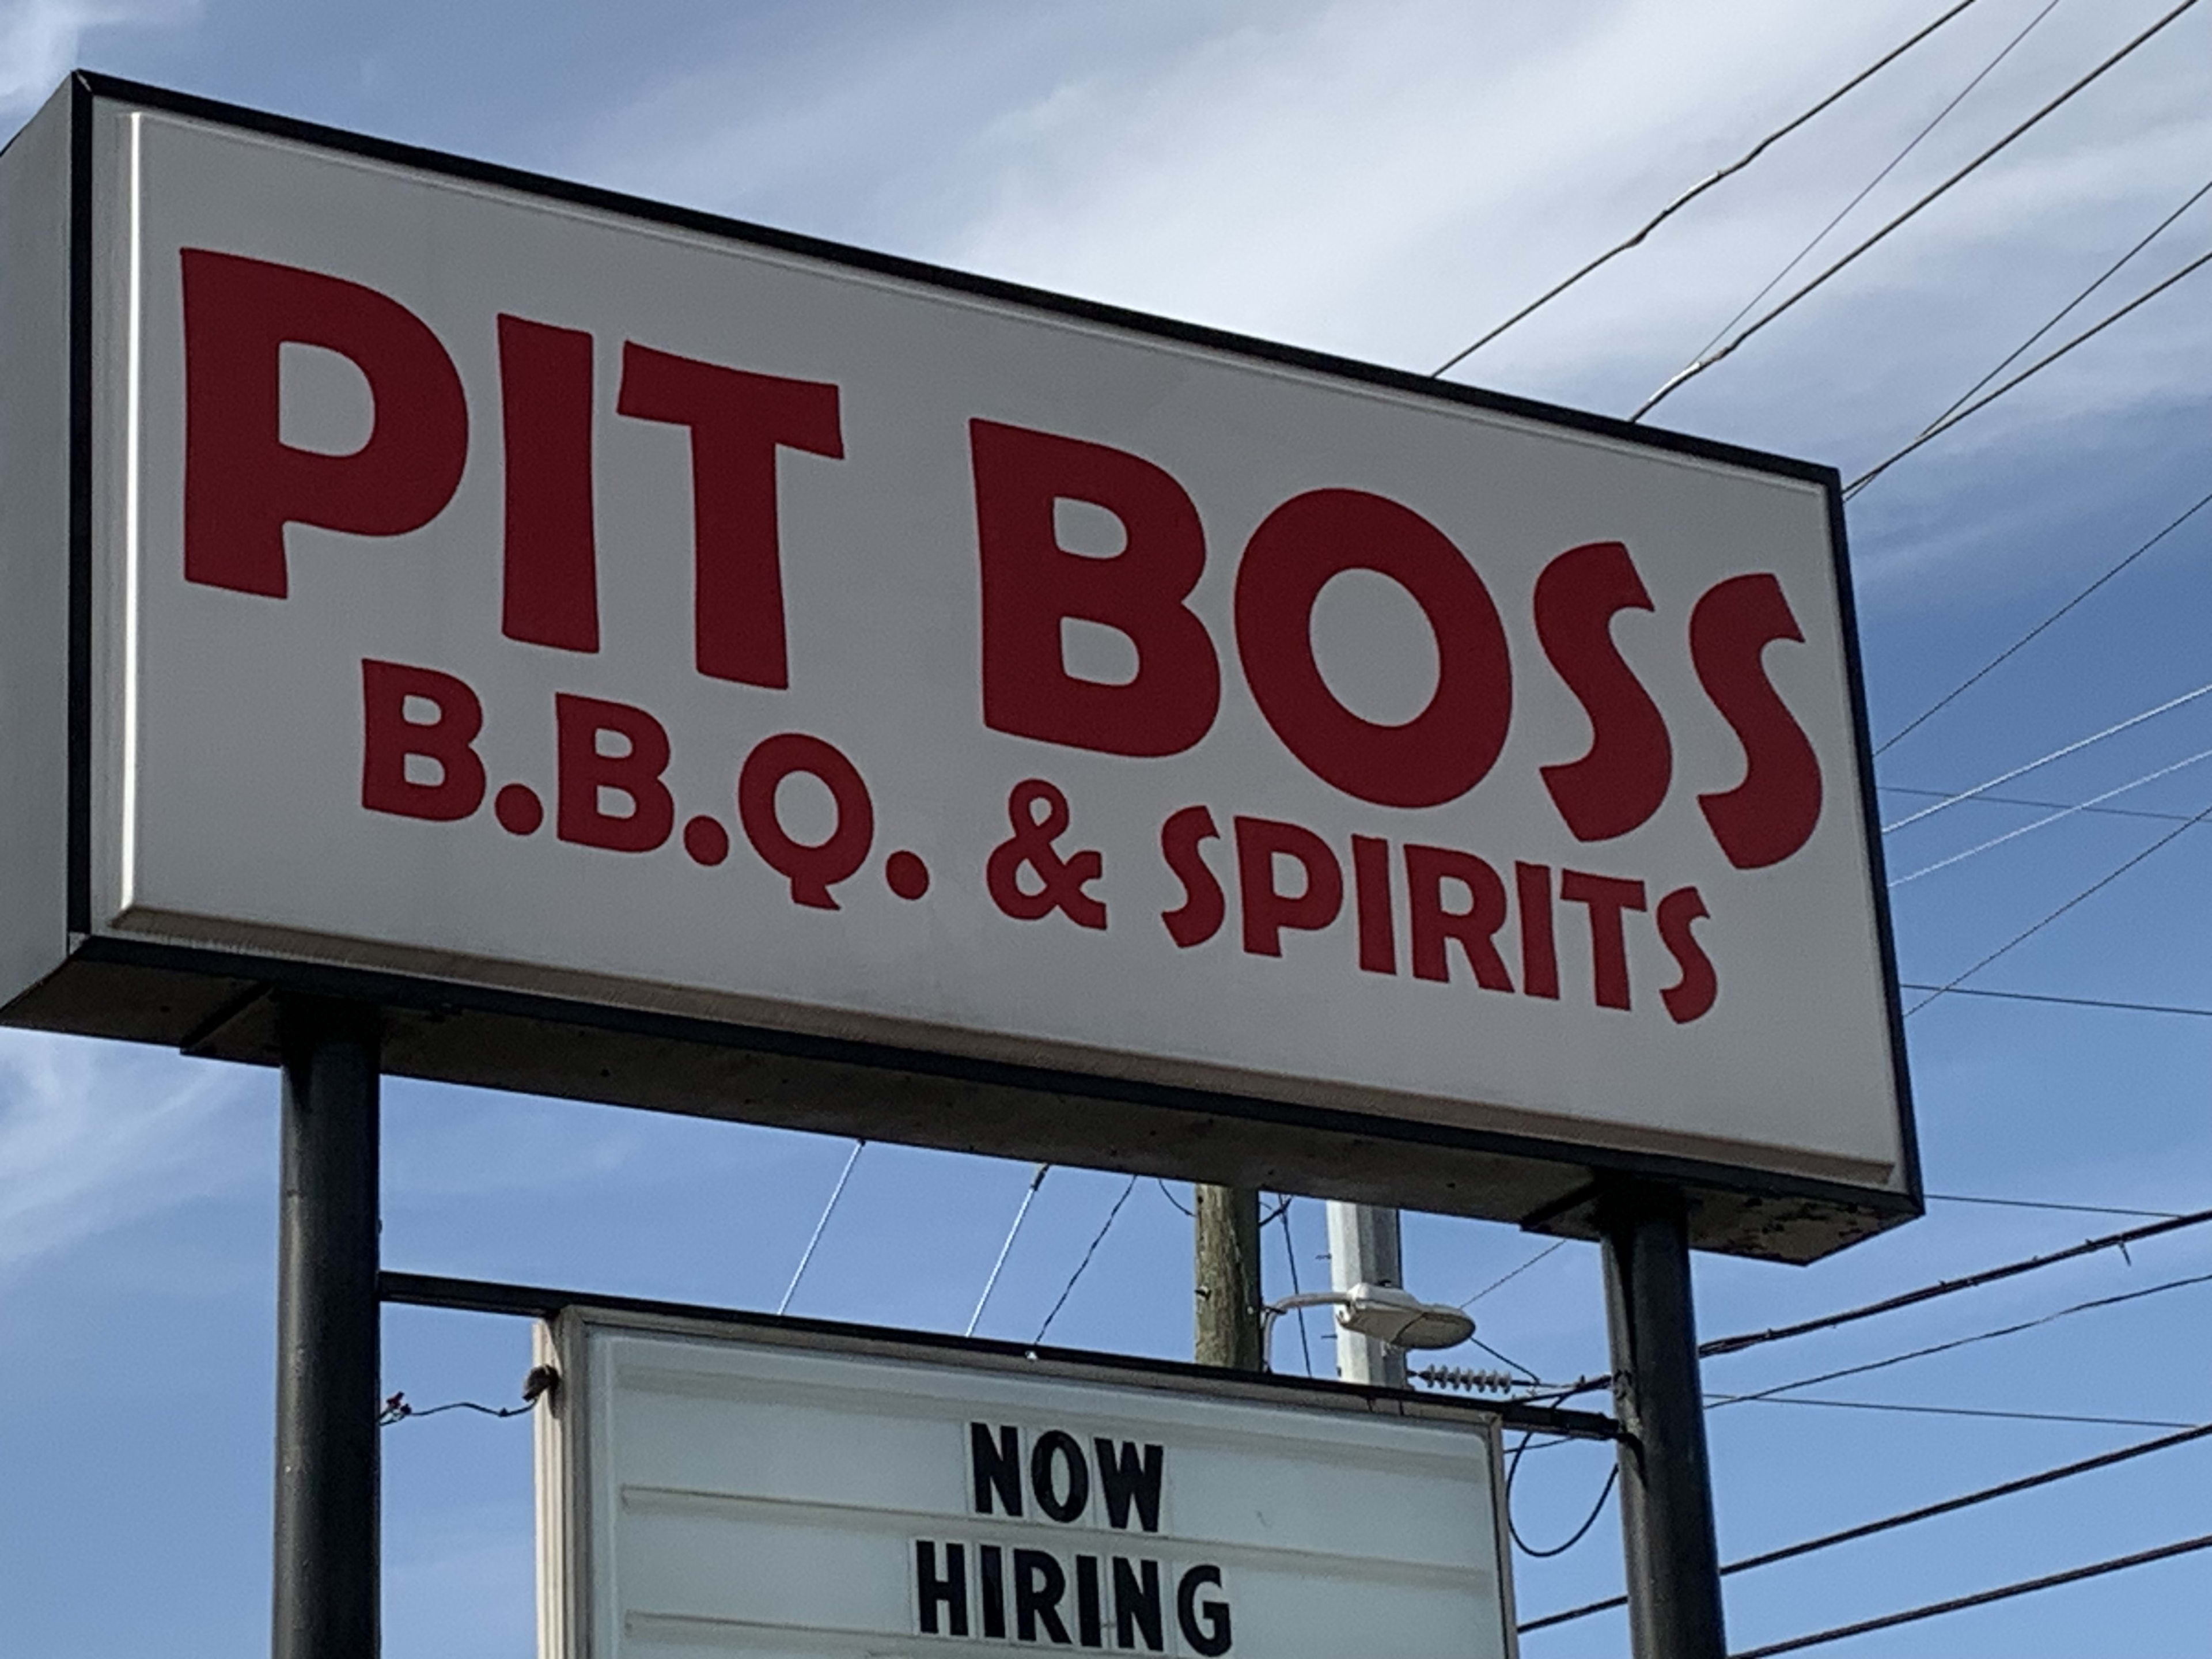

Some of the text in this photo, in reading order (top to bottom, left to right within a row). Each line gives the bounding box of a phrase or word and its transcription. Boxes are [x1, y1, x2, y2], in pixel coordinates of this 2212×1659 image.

[180, 249, 1823, 869] PIT BOSS
[362, 659, 1718, 1023] B.B.Q. & SPIRITS
[915, 1539, 1233, 1659] HIRING
[969, 1421, 1165, 1535] NOW
